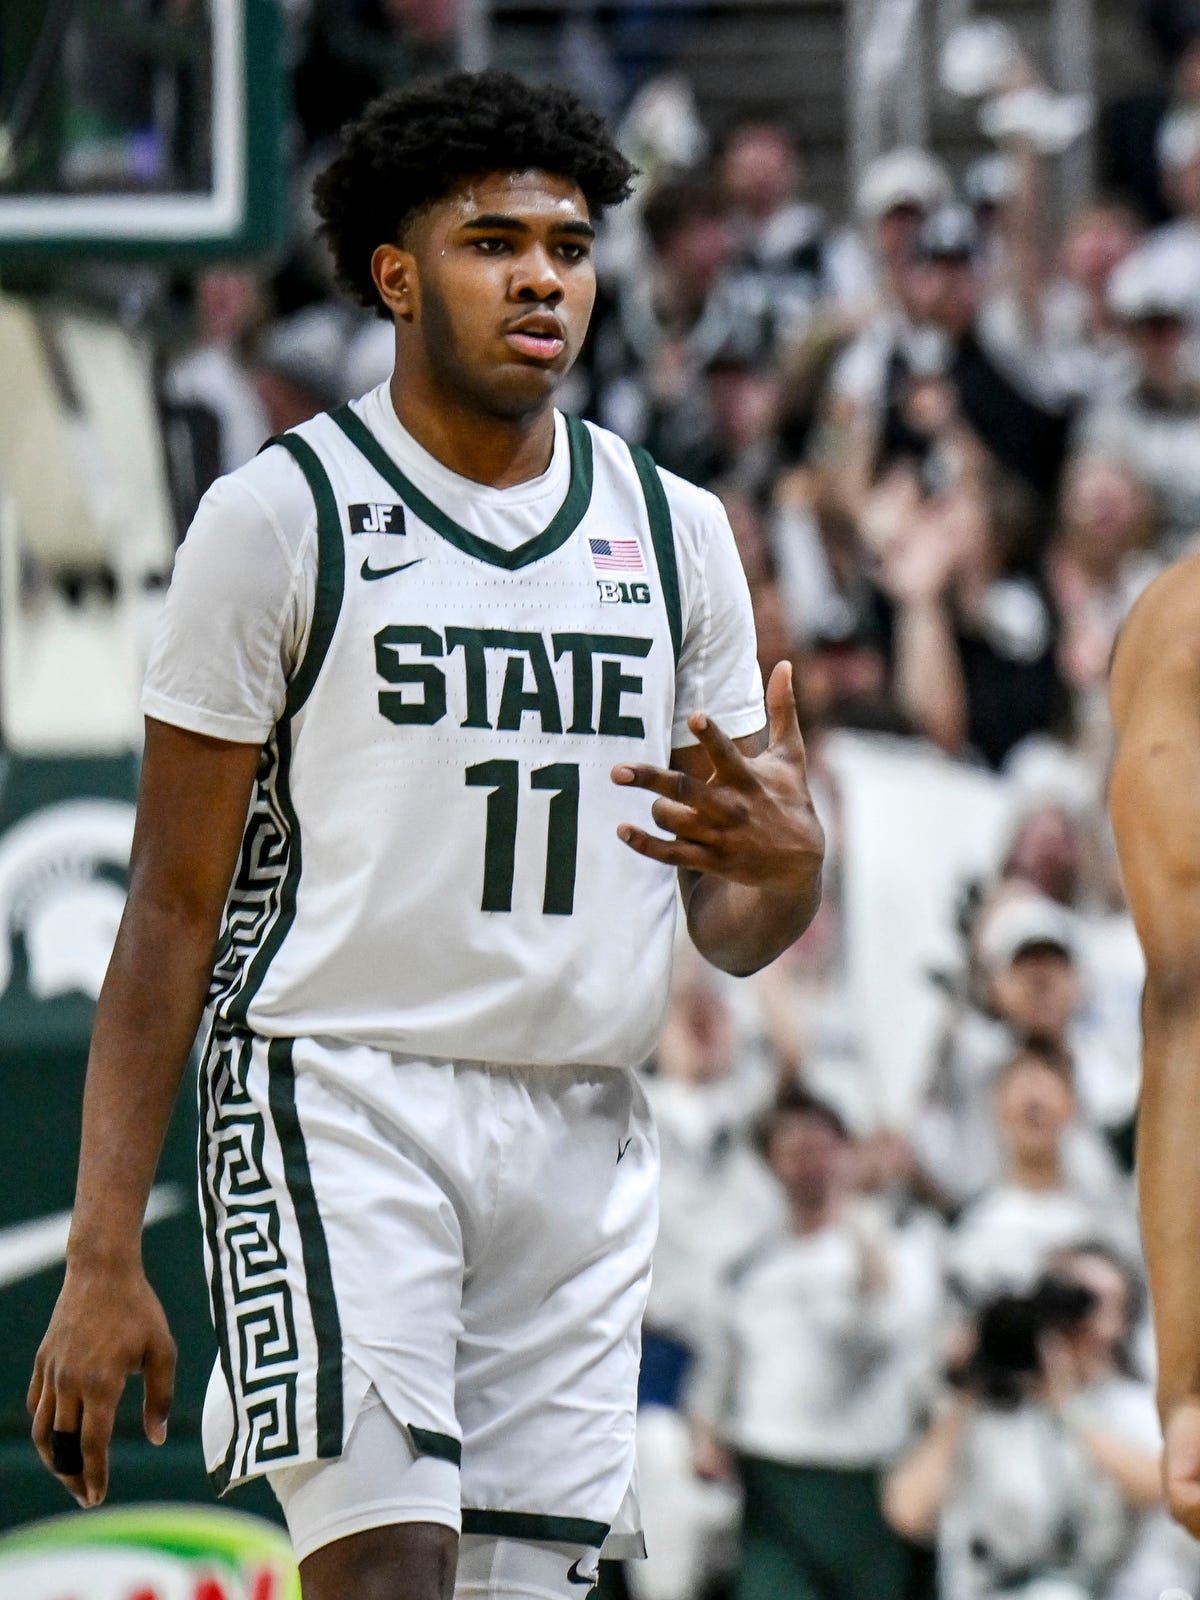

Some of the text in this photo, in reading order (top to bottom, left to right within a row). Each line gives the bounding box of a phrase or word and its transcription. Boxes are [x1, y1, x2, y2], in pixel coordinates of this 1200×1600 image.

[362, 503, 394, 533] JF
[373, 624, 654, 739] STATE
[464, 759, 580, 915] 11
